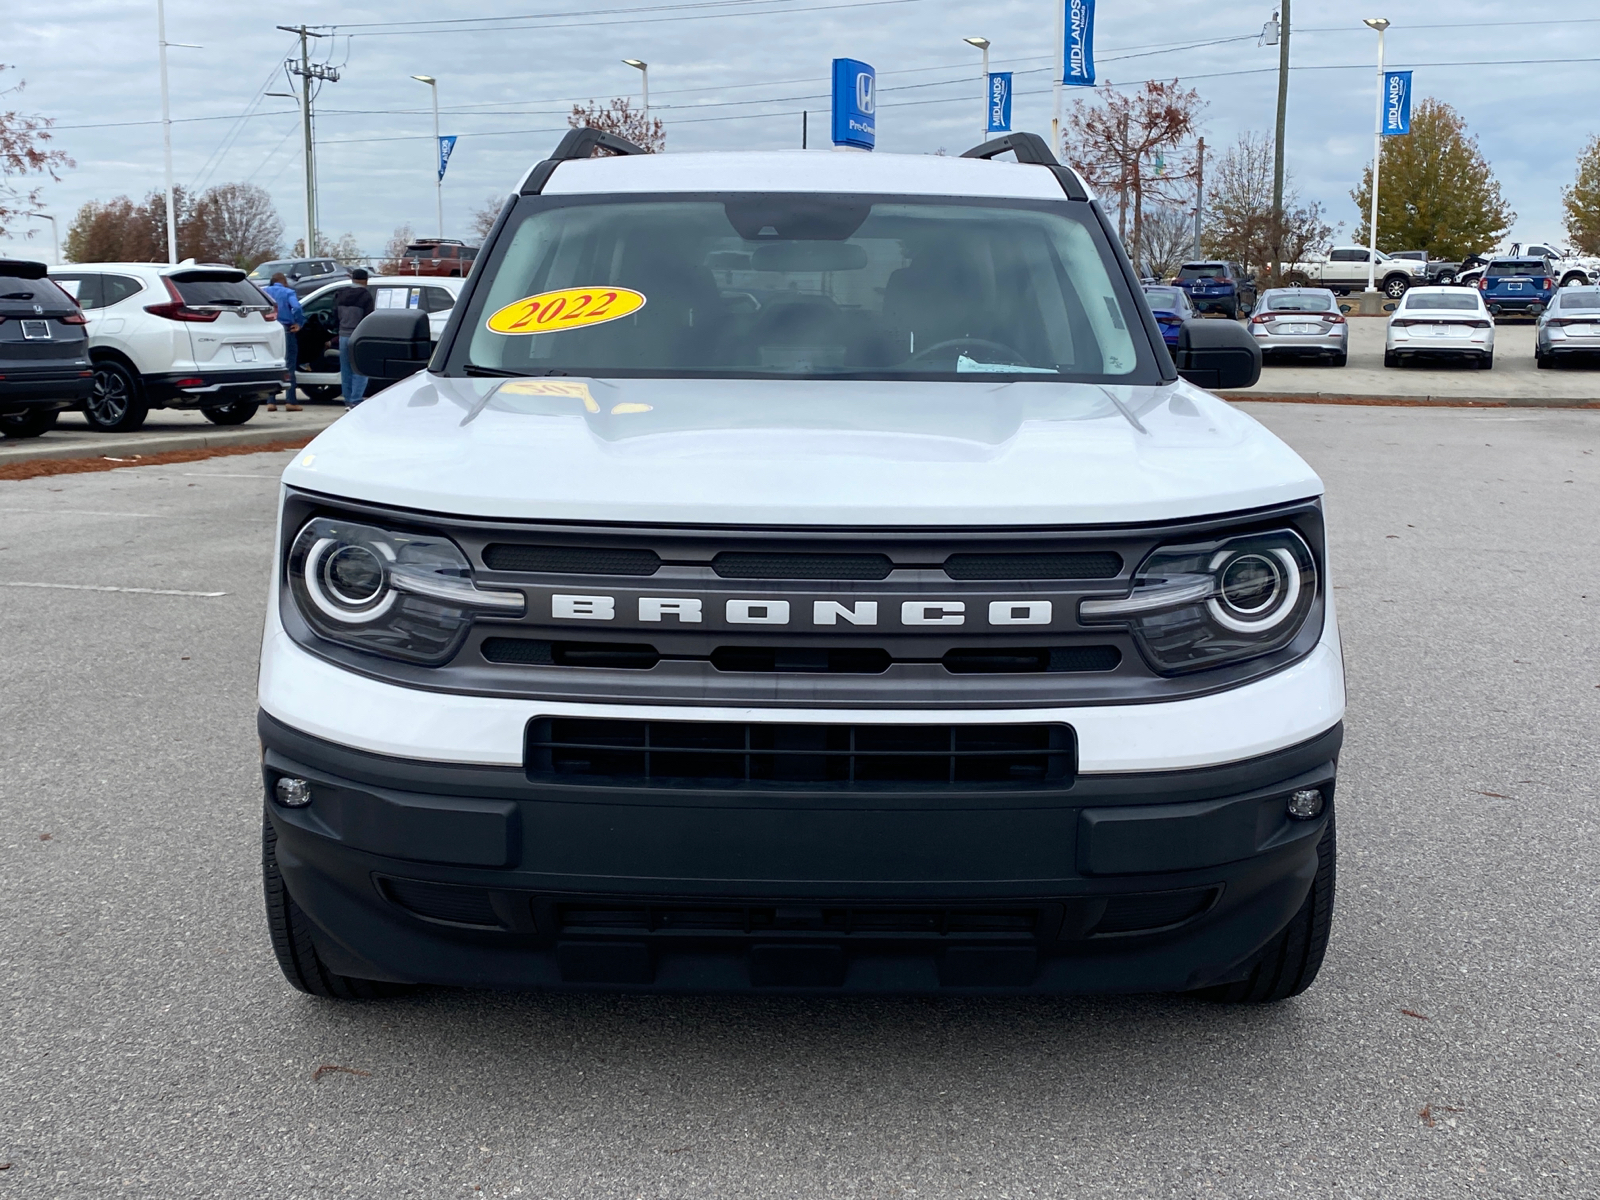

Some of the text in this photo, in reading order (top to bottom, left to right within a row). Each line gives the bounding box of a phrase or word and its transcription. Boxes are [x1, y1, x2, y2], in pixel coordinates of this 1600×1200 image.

[1071, 0, 1081, 76] MIDLANDS
[992, 77, 1001, 126] MIDLANDS
[1388, 76, 1399, 129] MIDLANDS
[508, 292, 617, 330] 2022
[552, 594, 1052, 625] BRONCO
